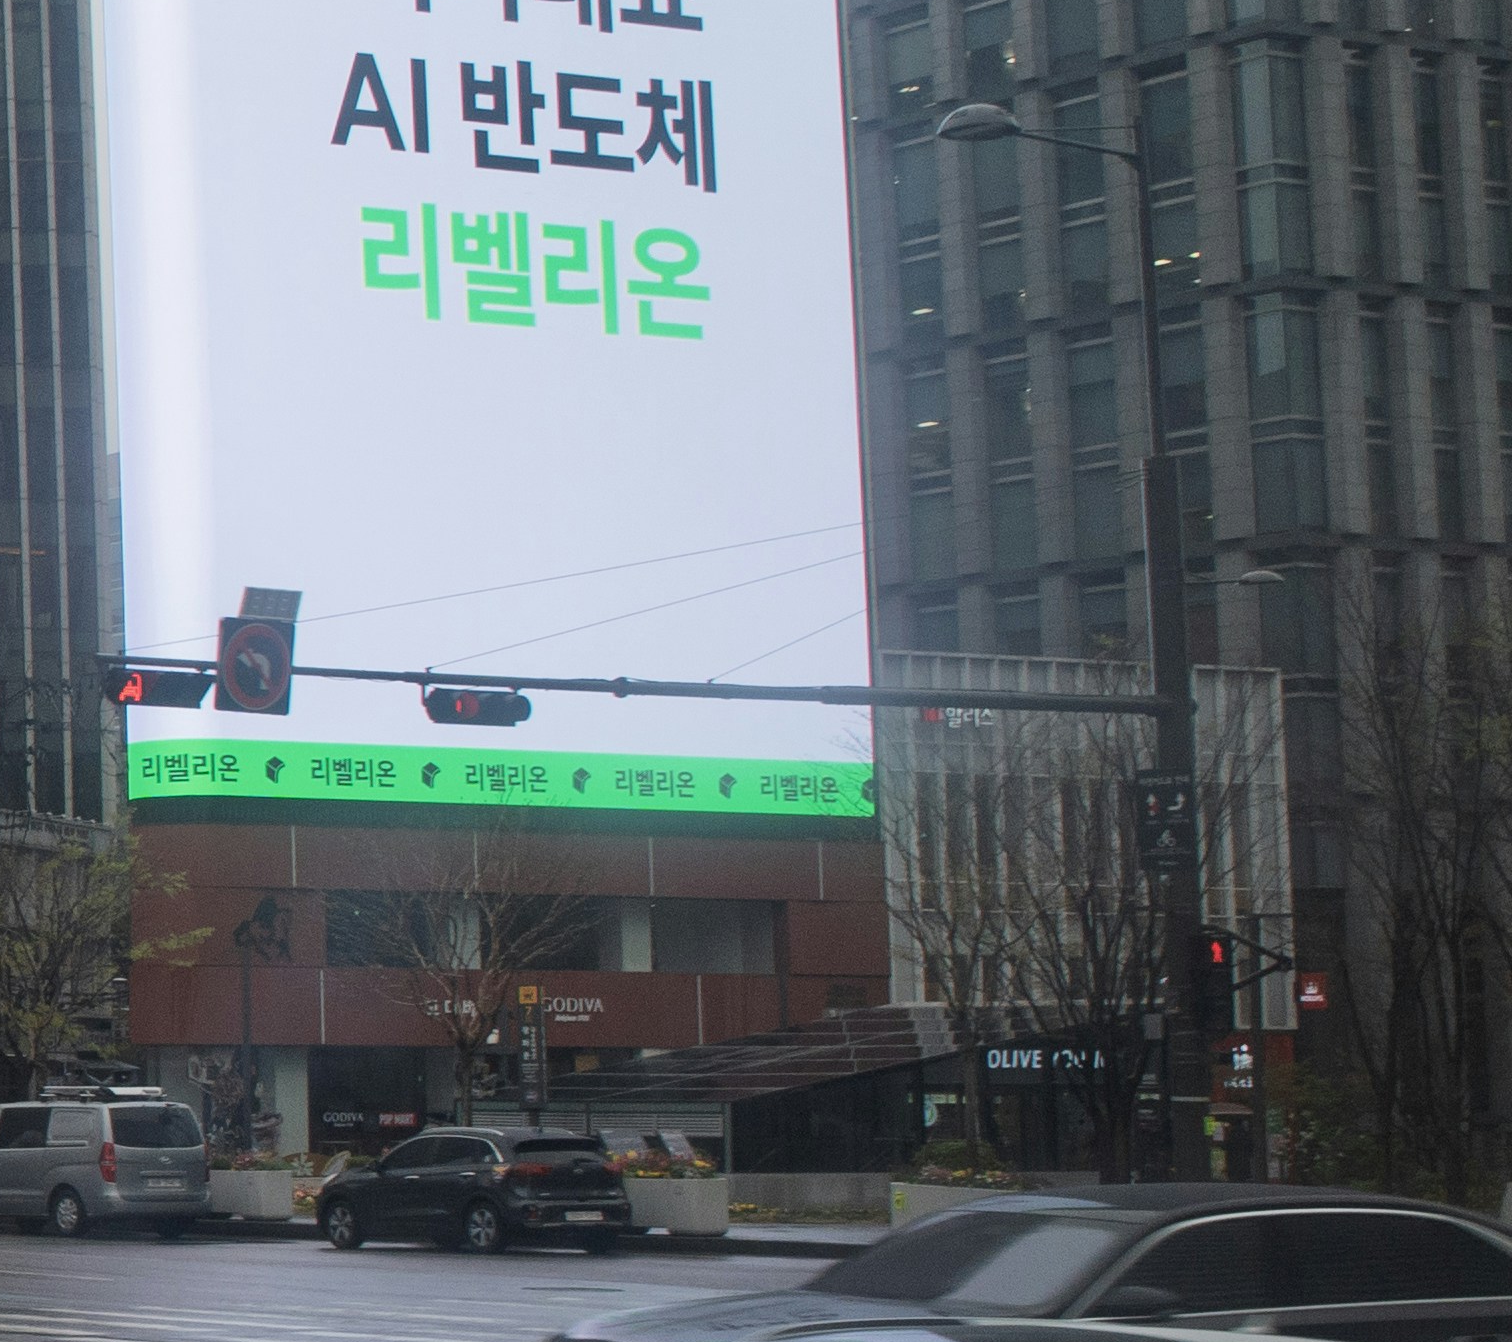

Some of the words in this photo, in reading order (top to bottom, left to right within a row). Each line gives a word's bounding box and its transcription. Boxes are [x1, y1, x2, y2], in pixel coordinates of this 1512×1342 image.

[330, 52, 431, 154] AI
[459, 61, 717, 193] 반도체
[360, 203, 710, 340] 리벨리온
[141, 754, 241, 786] 리벨리온
[309, 758, 397, 791] 리벨리온
[464, 763, 549, 795] 리벨리온
[614, 768, 696, 800] 리벨리온
[759, 773, 841, 804] 리벨리온
[987, 1048, 1043, 1070] OLIVE
